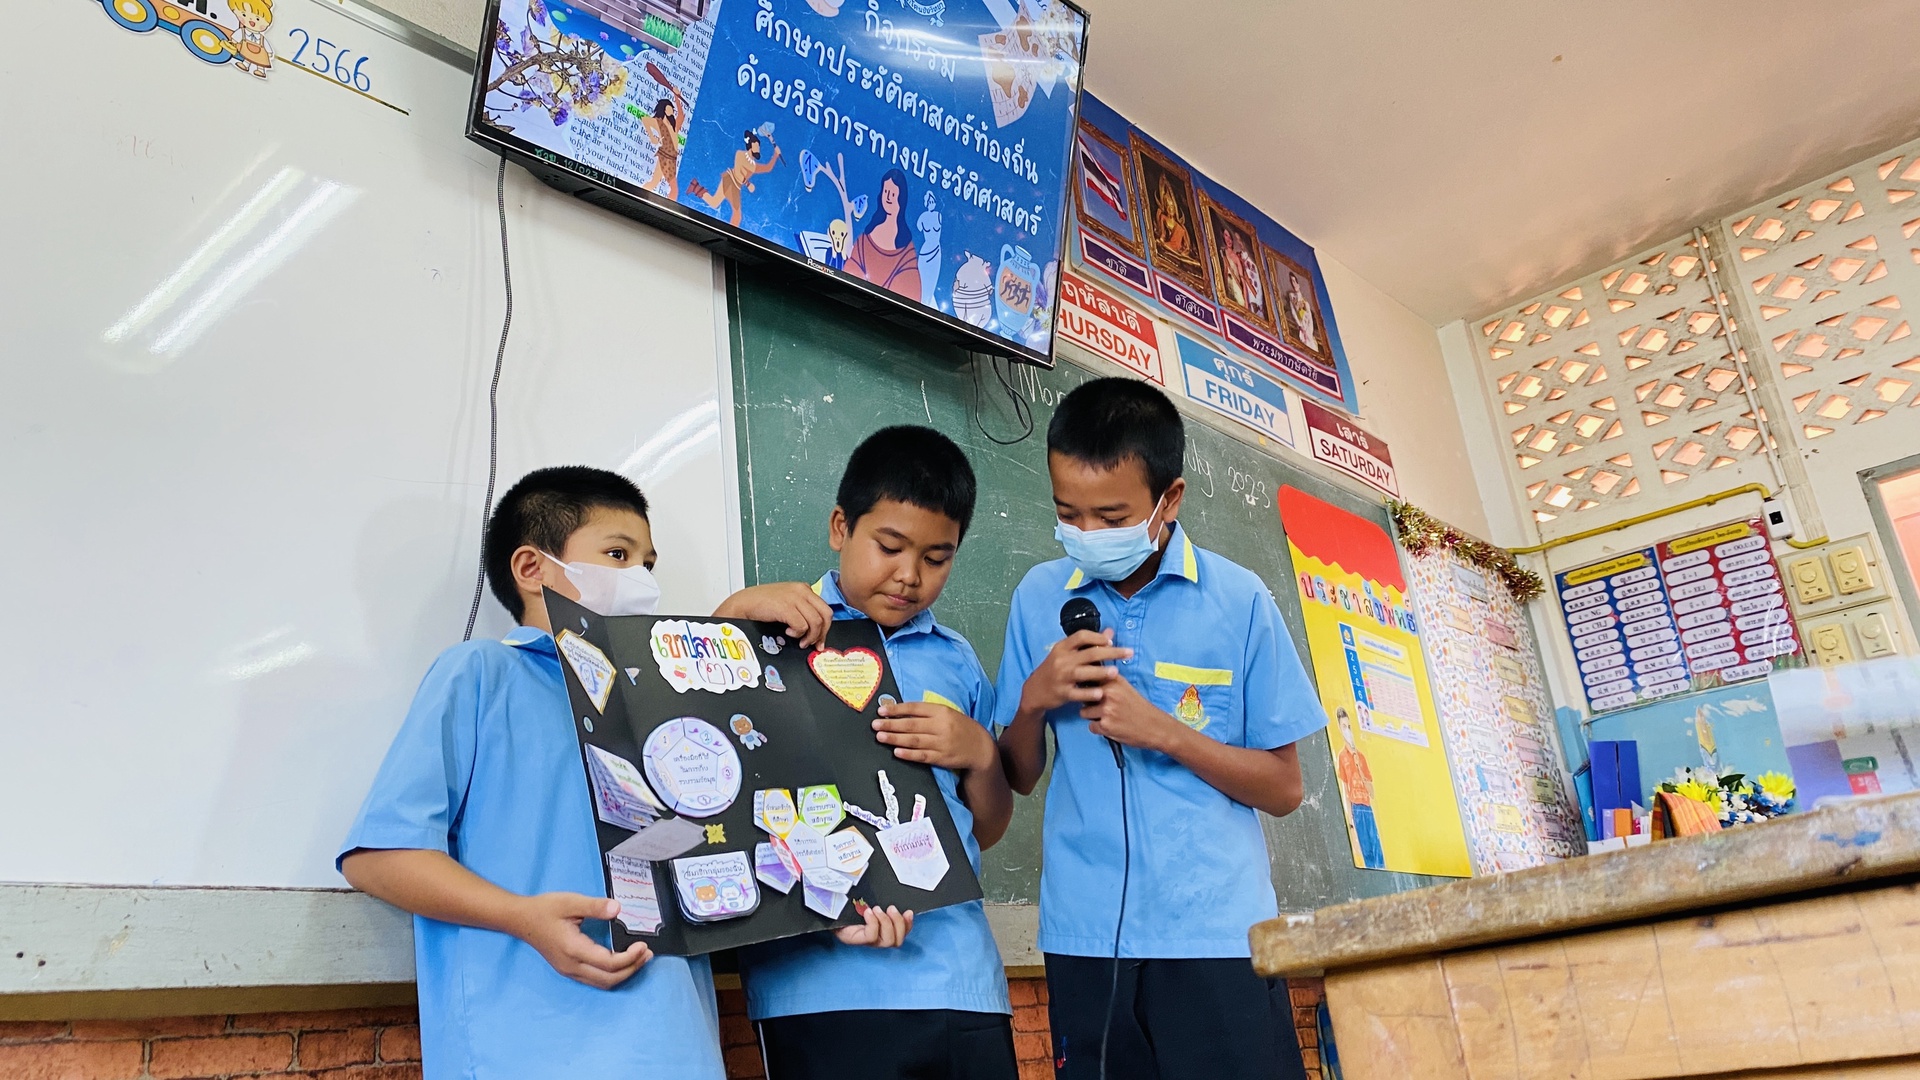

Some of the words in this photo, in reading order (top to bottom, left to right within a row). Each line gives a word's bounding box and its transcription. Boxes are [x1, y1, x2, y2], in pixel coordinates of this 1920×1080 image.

[289, 28, 371, 92] 2566
[756, 0, 1039, 185] ศึกษาประวัติศาสตร์ท้องถิ่น
[585, 147, 605, 161] your
[605, 155, 628, 174] hands
[629, 170, 645, 185] take
[603, 142, 623, 158] when
[622, 141, 638, 156] you
[638, 149, 655, 165] who
[737, 54, 1042, 236] ด้วยวิธีการทางประวัติศาสตร์
[1106, 256, 1127, 276] ชาติ
[1061, 280, 1141, 334] ฤหัสบดี
[1174, 293, 1205, 320] ศาสนา
[1059, 308, 1151, 370] HURSDAY
[1252, 337, 1319, 381] พระมหากษัตริย์
[1213, 357, 1255, 388] ศุกร์
[1205, 379, 1275, 429] FRIDAY
[1336, 422, 1369, 450] เสาร์
[1320, 438, 1390, 487] SATURDAY
[1228, 466, 1270, 509] 2023
[1300, 576, 1416, 632] ประชาสัมพันธ์
